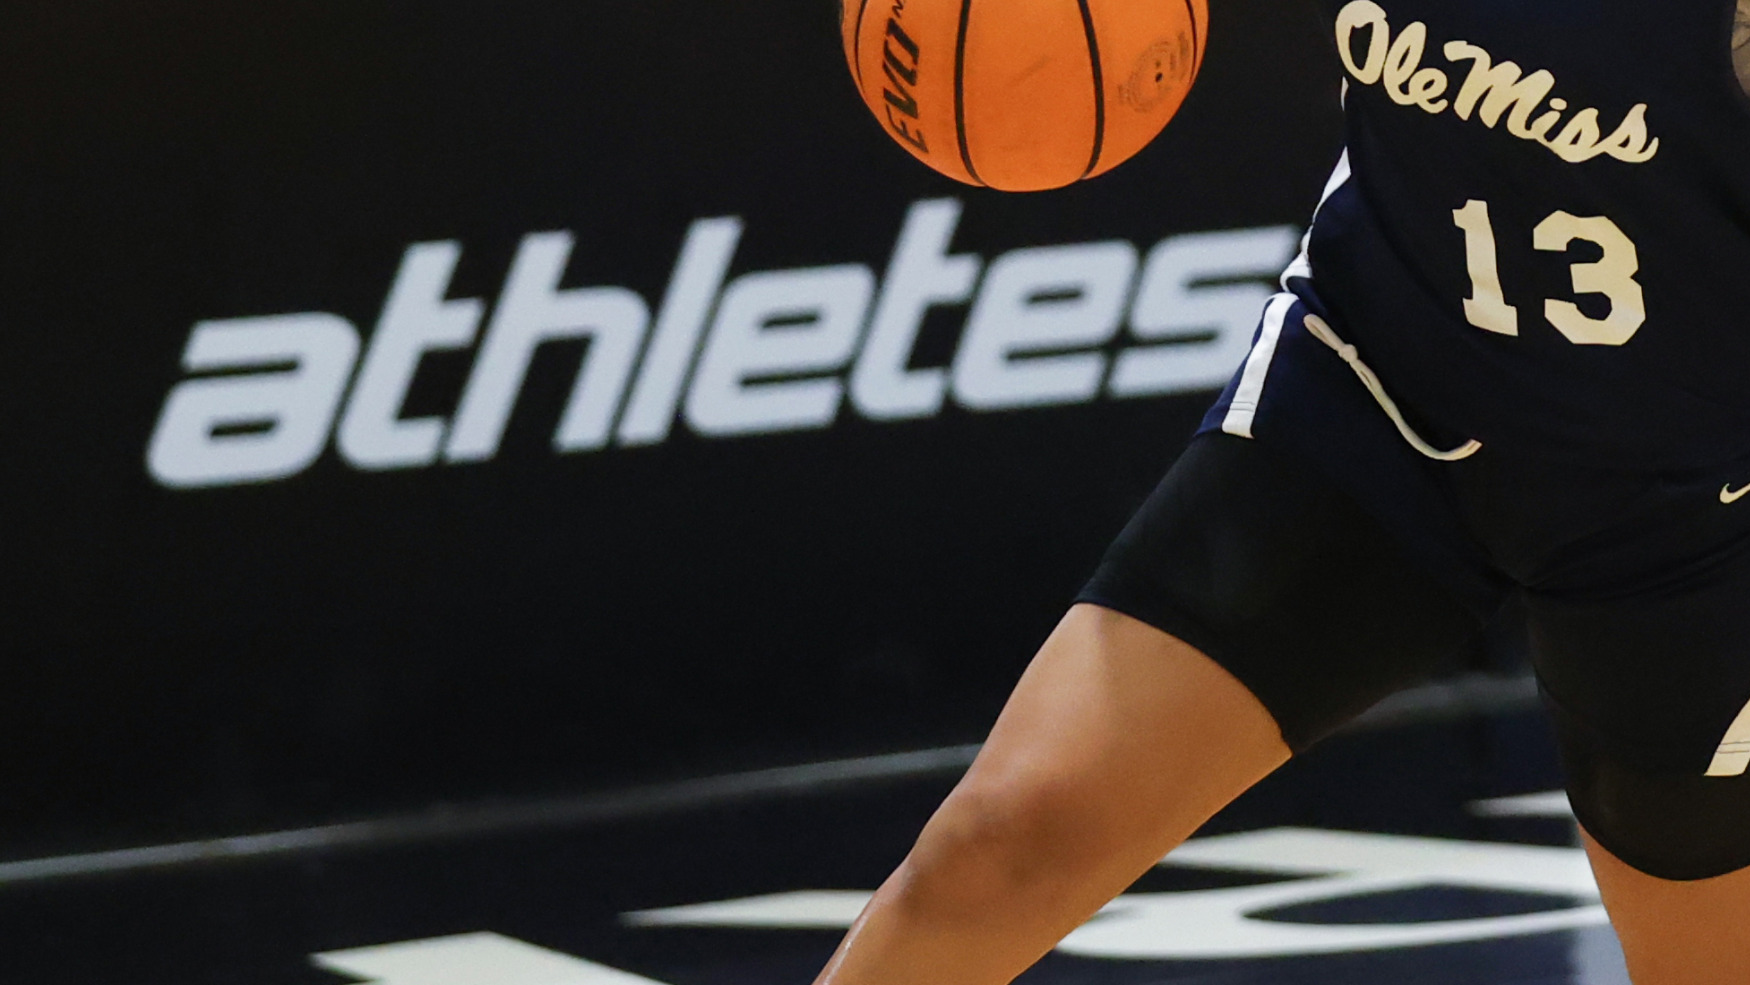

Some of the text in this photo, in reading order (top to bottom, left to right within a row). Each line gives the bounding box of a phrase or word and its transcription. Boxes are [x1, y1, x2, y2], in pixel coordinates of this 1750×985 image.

[1443, 39, 1660, 163] Miss
[145, 197, 1300, 490] athletes
[1451, 198, 1647, 346] 13
